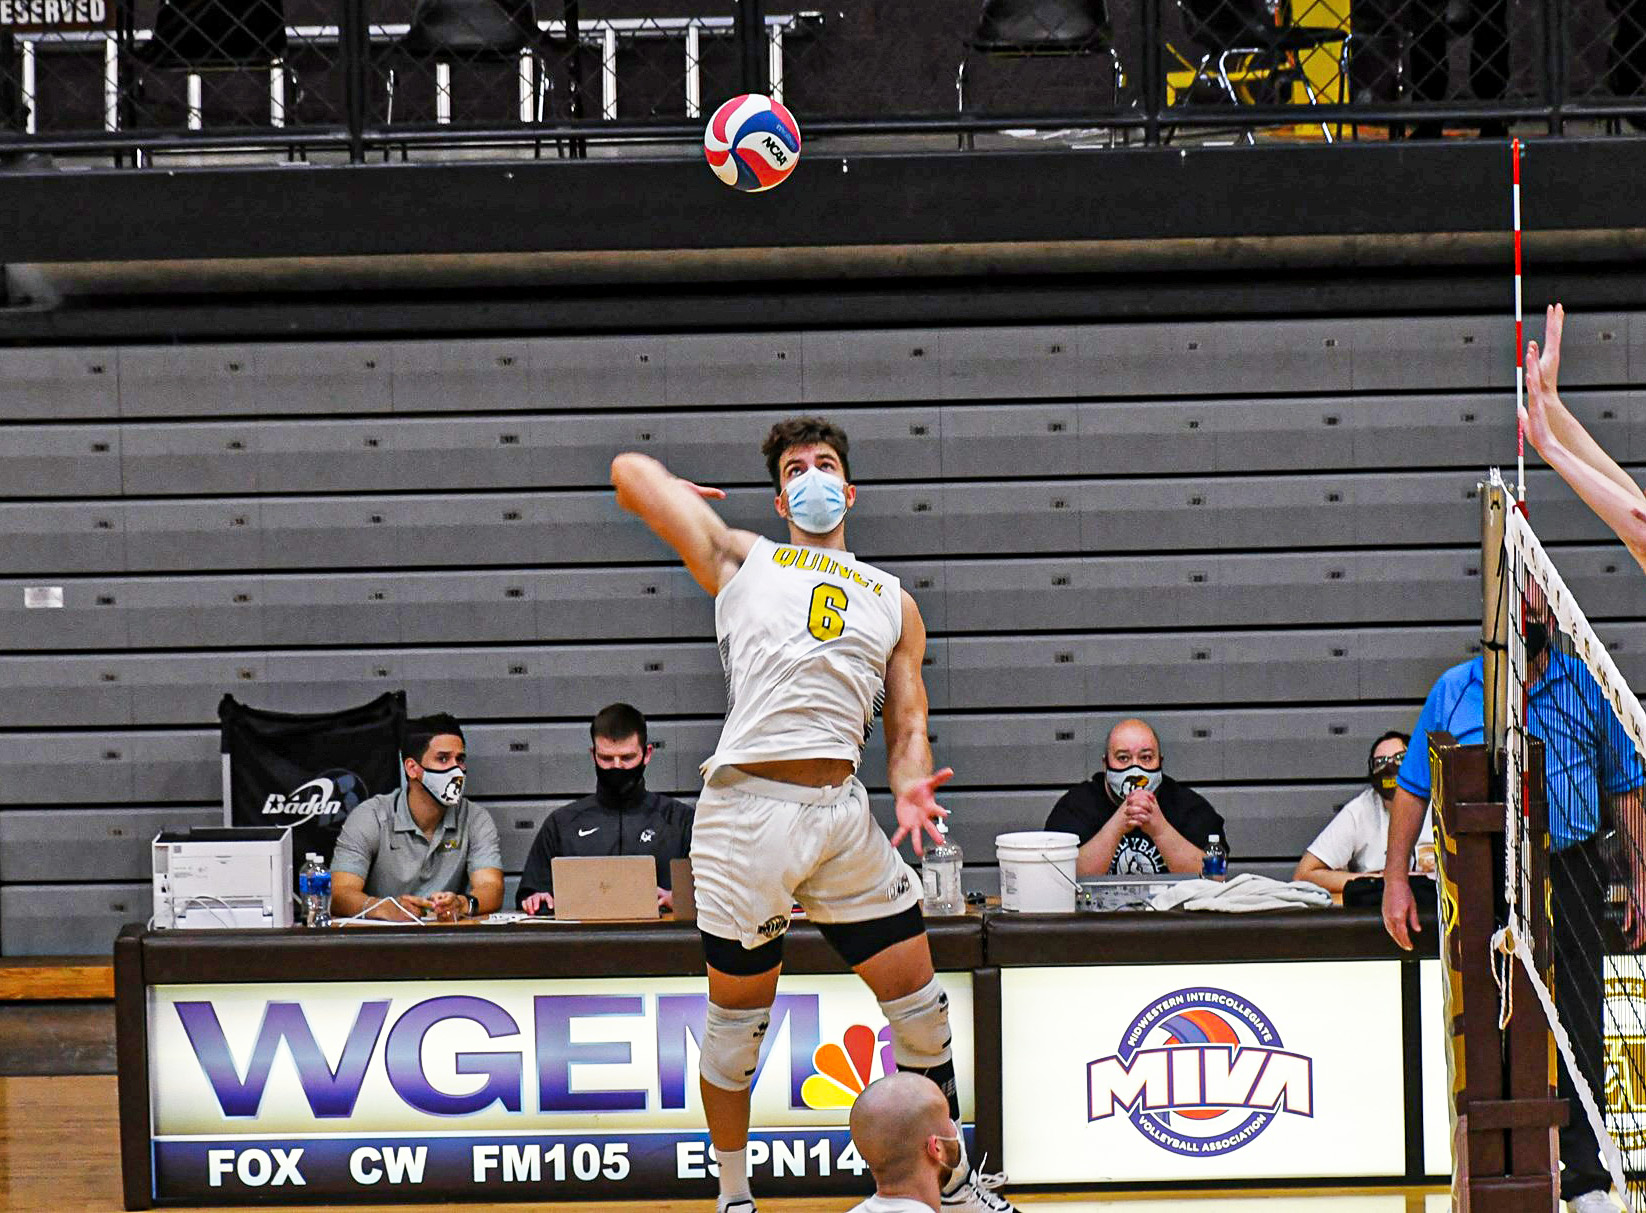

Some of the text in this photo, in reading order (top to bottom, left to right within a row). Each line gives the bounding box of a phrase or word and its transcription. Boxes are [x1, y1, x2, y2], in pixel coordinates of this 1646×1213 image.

[761, 136, 789, 167] NCAA
[806, 581, 849, 642] 6
[1127, 991, 1274, 1048] MIDWESTERN INTERCOLLEGIATE
[173, 992, 820, 1120] WGEM
[1086, 1045, 1314, 1124] MIVA
[1137, 1113, 1268, 1153] VOLLEYBALL ASSOCIATION
[207, 1138, 870, 1188] FOX CW FM105 EPN14
